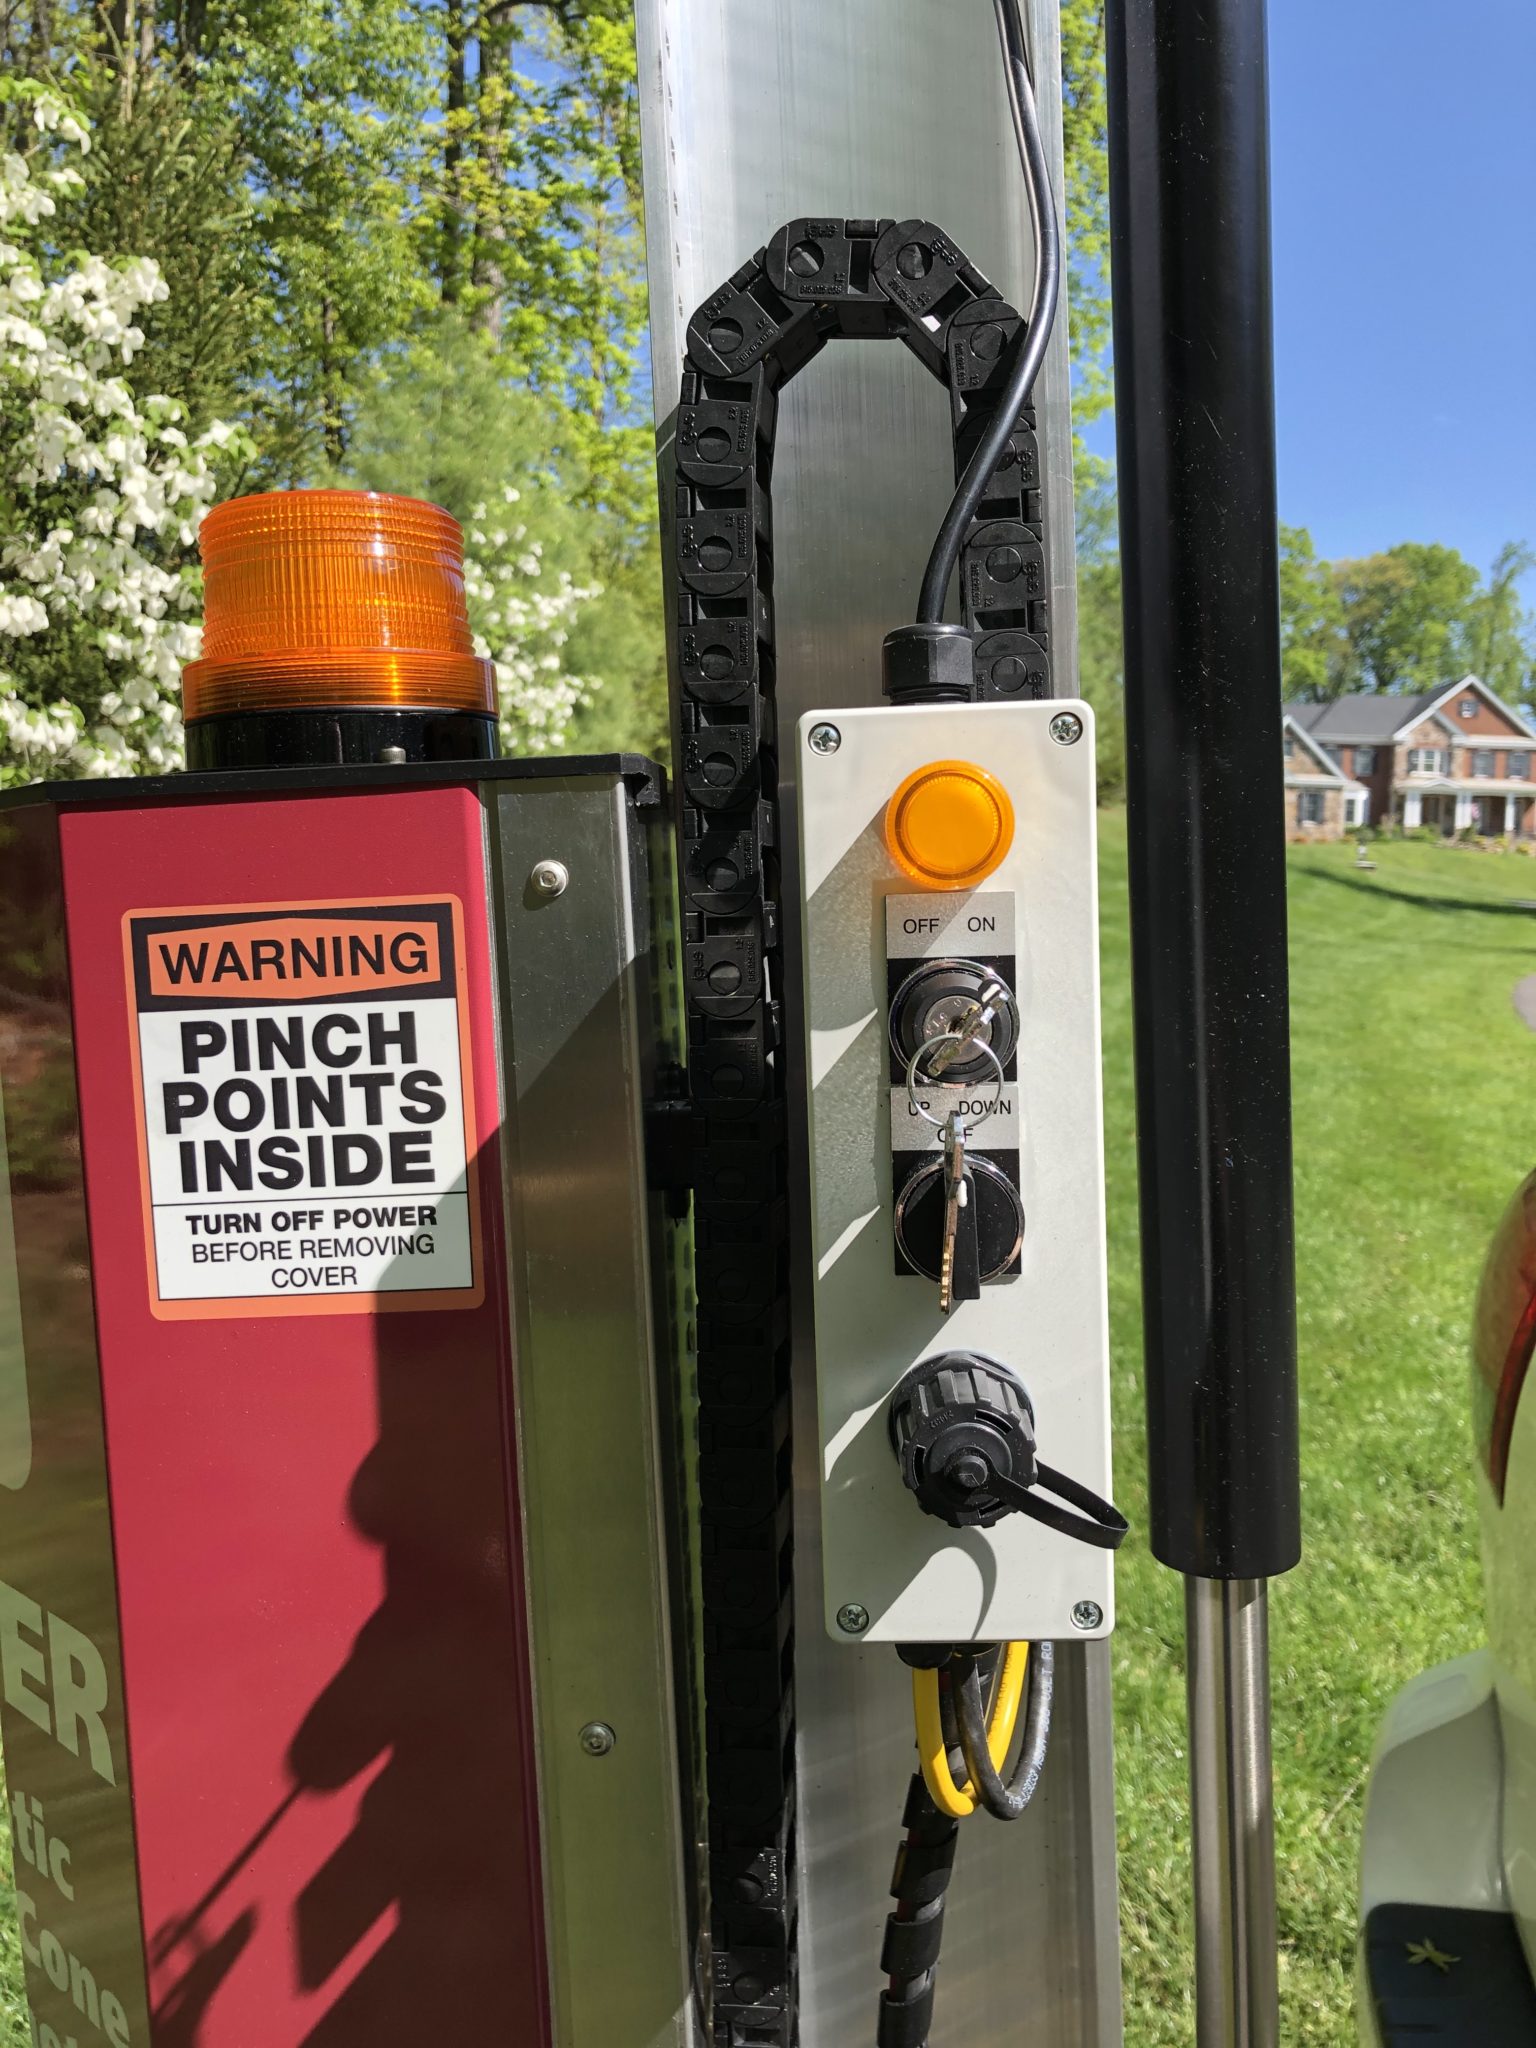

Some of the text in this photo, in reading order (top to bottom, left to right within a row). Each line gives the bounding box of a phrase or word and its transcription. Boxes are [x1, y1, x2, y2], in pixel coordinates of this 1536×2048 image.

[903, 916, 996, 934] OFF ON
[159, 932, 429, 985] WARNING
[180, 1011, 418, 1074] PINCH
[162, 1070, 447, 1134] POINTS
[908, 1100, 1011, 1116] UP DOWN
[937, 1128, 974, 1143] OF
[179, 1131, 436, 1193] INSIDE
[185, 1205, 437, 1236] TURN OFF POWER
[192, 1234, 435, 1263] BEFORE REMOVING
[271, 1266, 358, 1288] COVER
